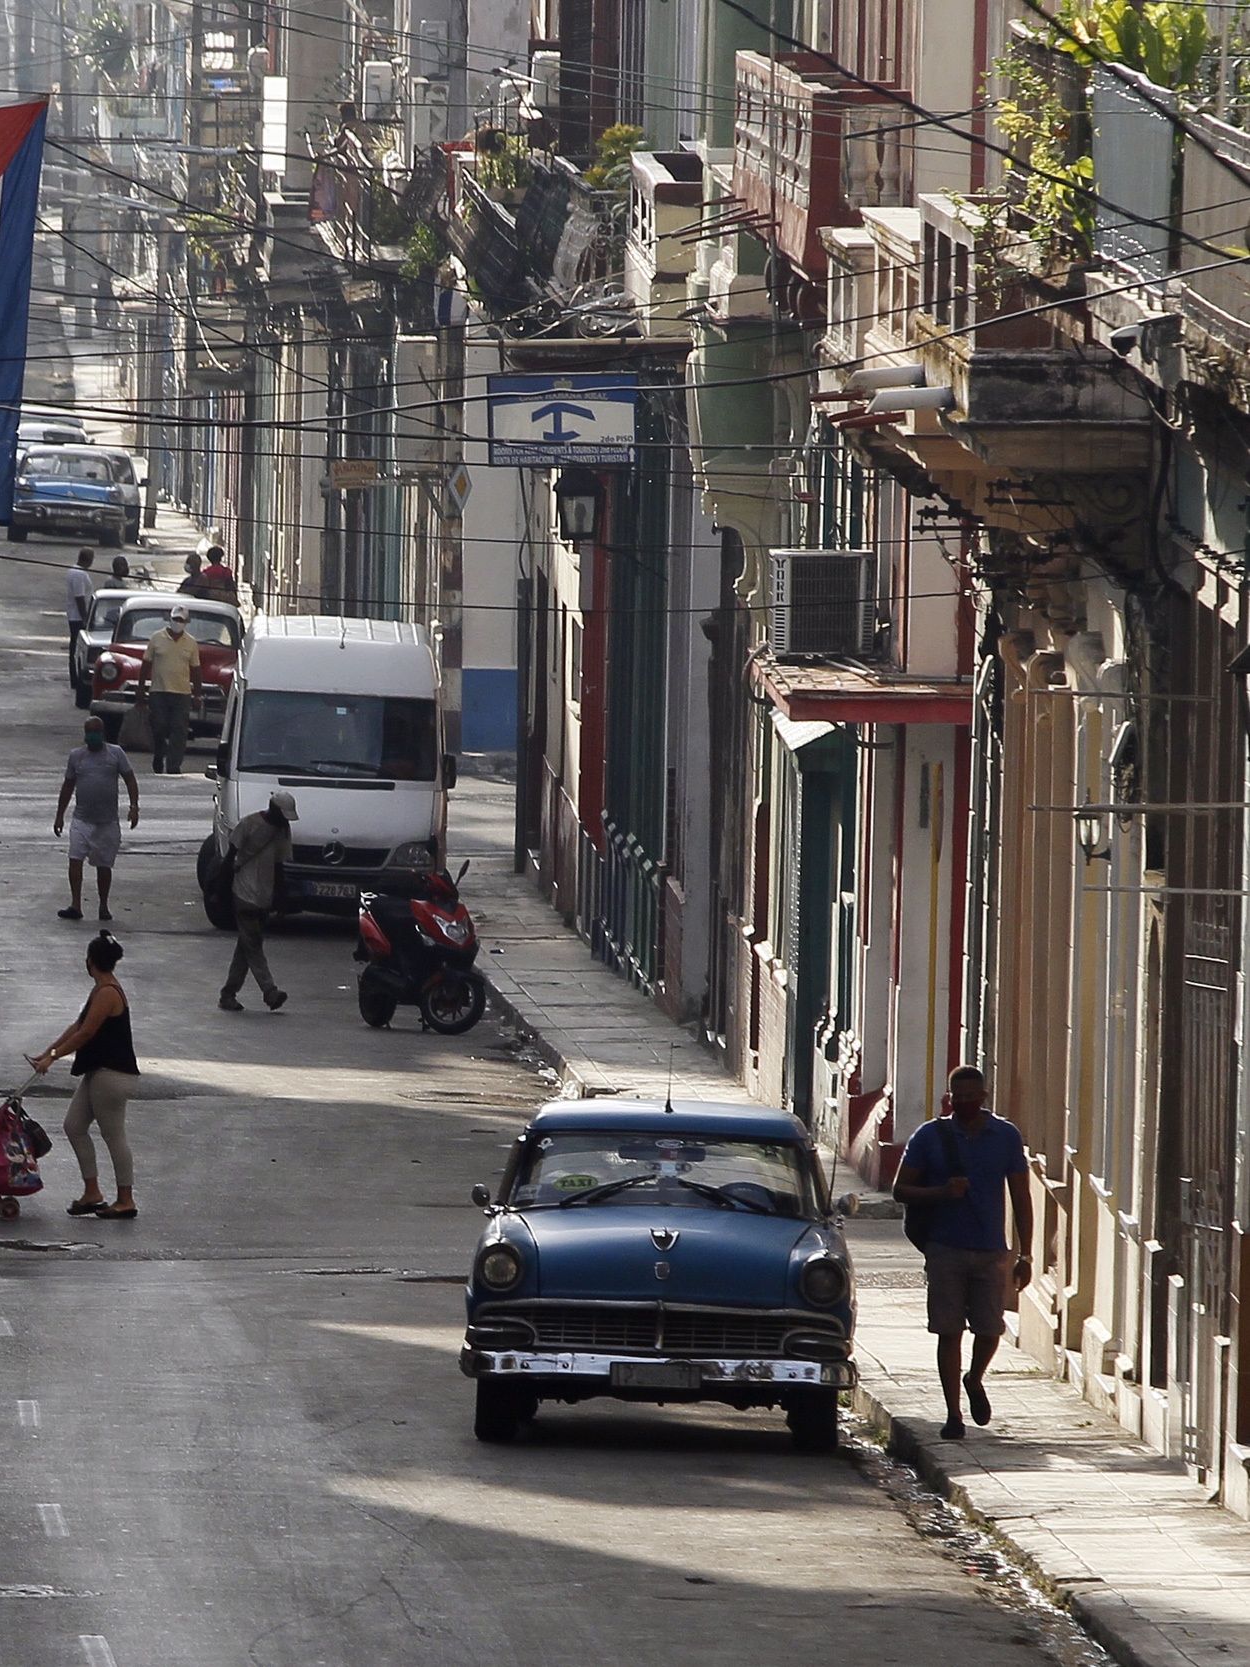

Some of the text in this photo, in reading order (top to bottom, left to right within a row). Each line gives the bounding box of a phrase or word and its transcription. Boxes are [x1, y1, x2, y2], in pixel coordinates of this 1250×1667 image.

[600, 435, 633, 443] 2do PISO
[511, 455, 519, 464] DE
[775, 559, 786, 602] YORK
[559, 1179, 593, 1187] TAXI
